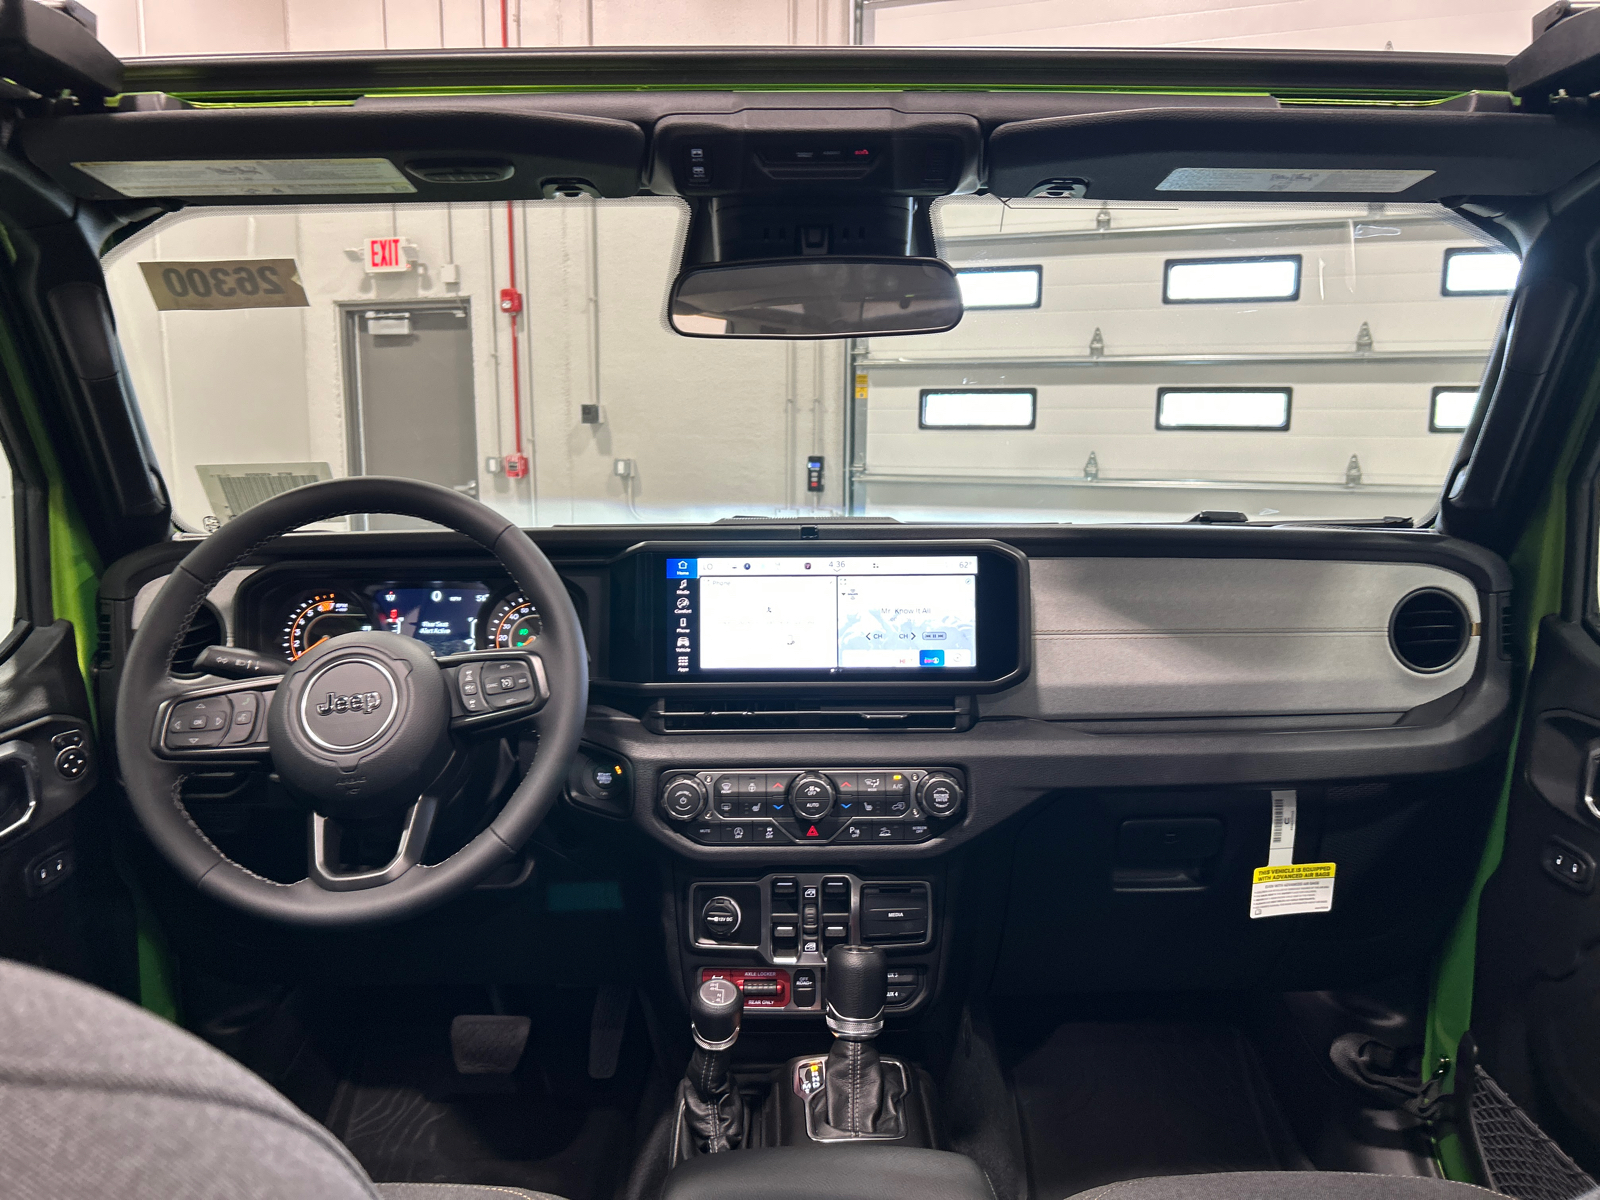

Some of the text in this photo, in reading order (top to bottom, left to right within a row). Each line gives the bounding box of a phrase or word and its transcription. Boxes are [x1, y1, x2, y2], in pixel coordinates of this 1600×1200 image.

[371, 239, 400, 267] EXIT
[431, 590, 442, 602] 0
[316, 691, 382, 716] Jeep
